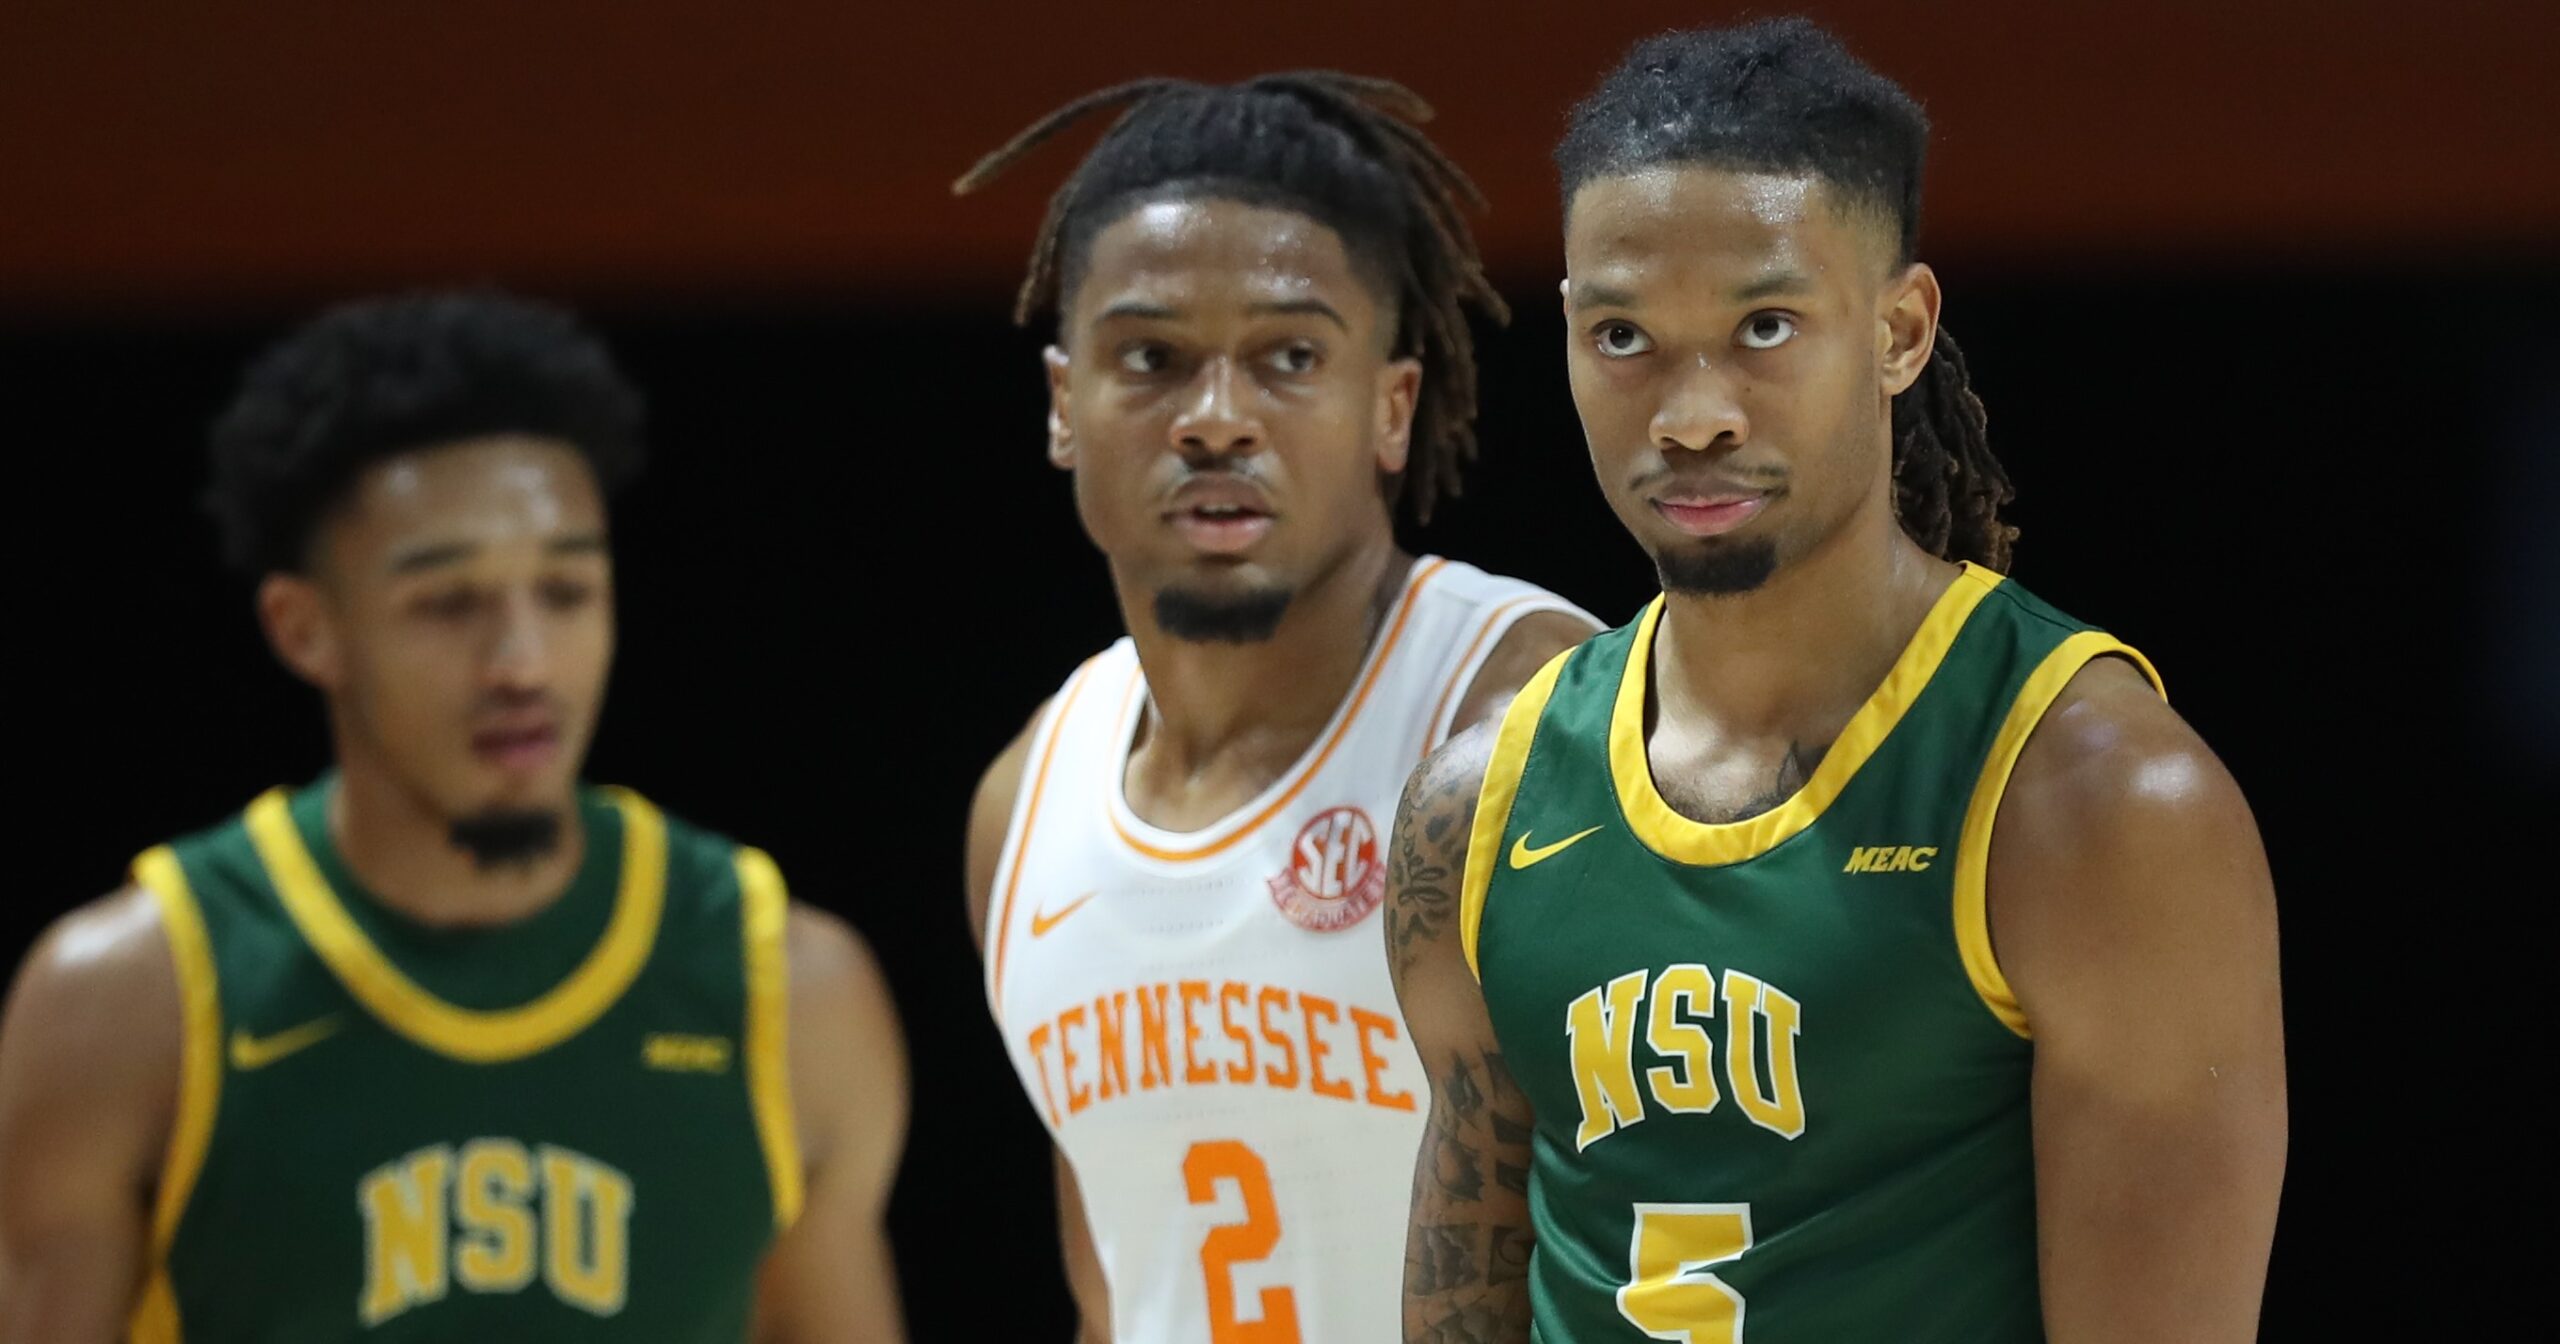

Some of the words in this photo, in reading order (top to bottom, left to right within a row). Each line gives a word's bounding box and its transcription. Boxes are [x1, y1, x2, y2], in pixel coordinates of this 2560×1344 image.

[1298, 811, 1374, 898] SEC
[1844, 845, 1938, 875] MEAC
[1028, 981, 1417, 1128] TENNESSEE
[1566, 964, 1806, 1154] NSU
[359, 1137, 634, 1325] NSU
[1182, 1139, 1304, 1344] 2
[1616, 1202, 1754, 1344] 5
